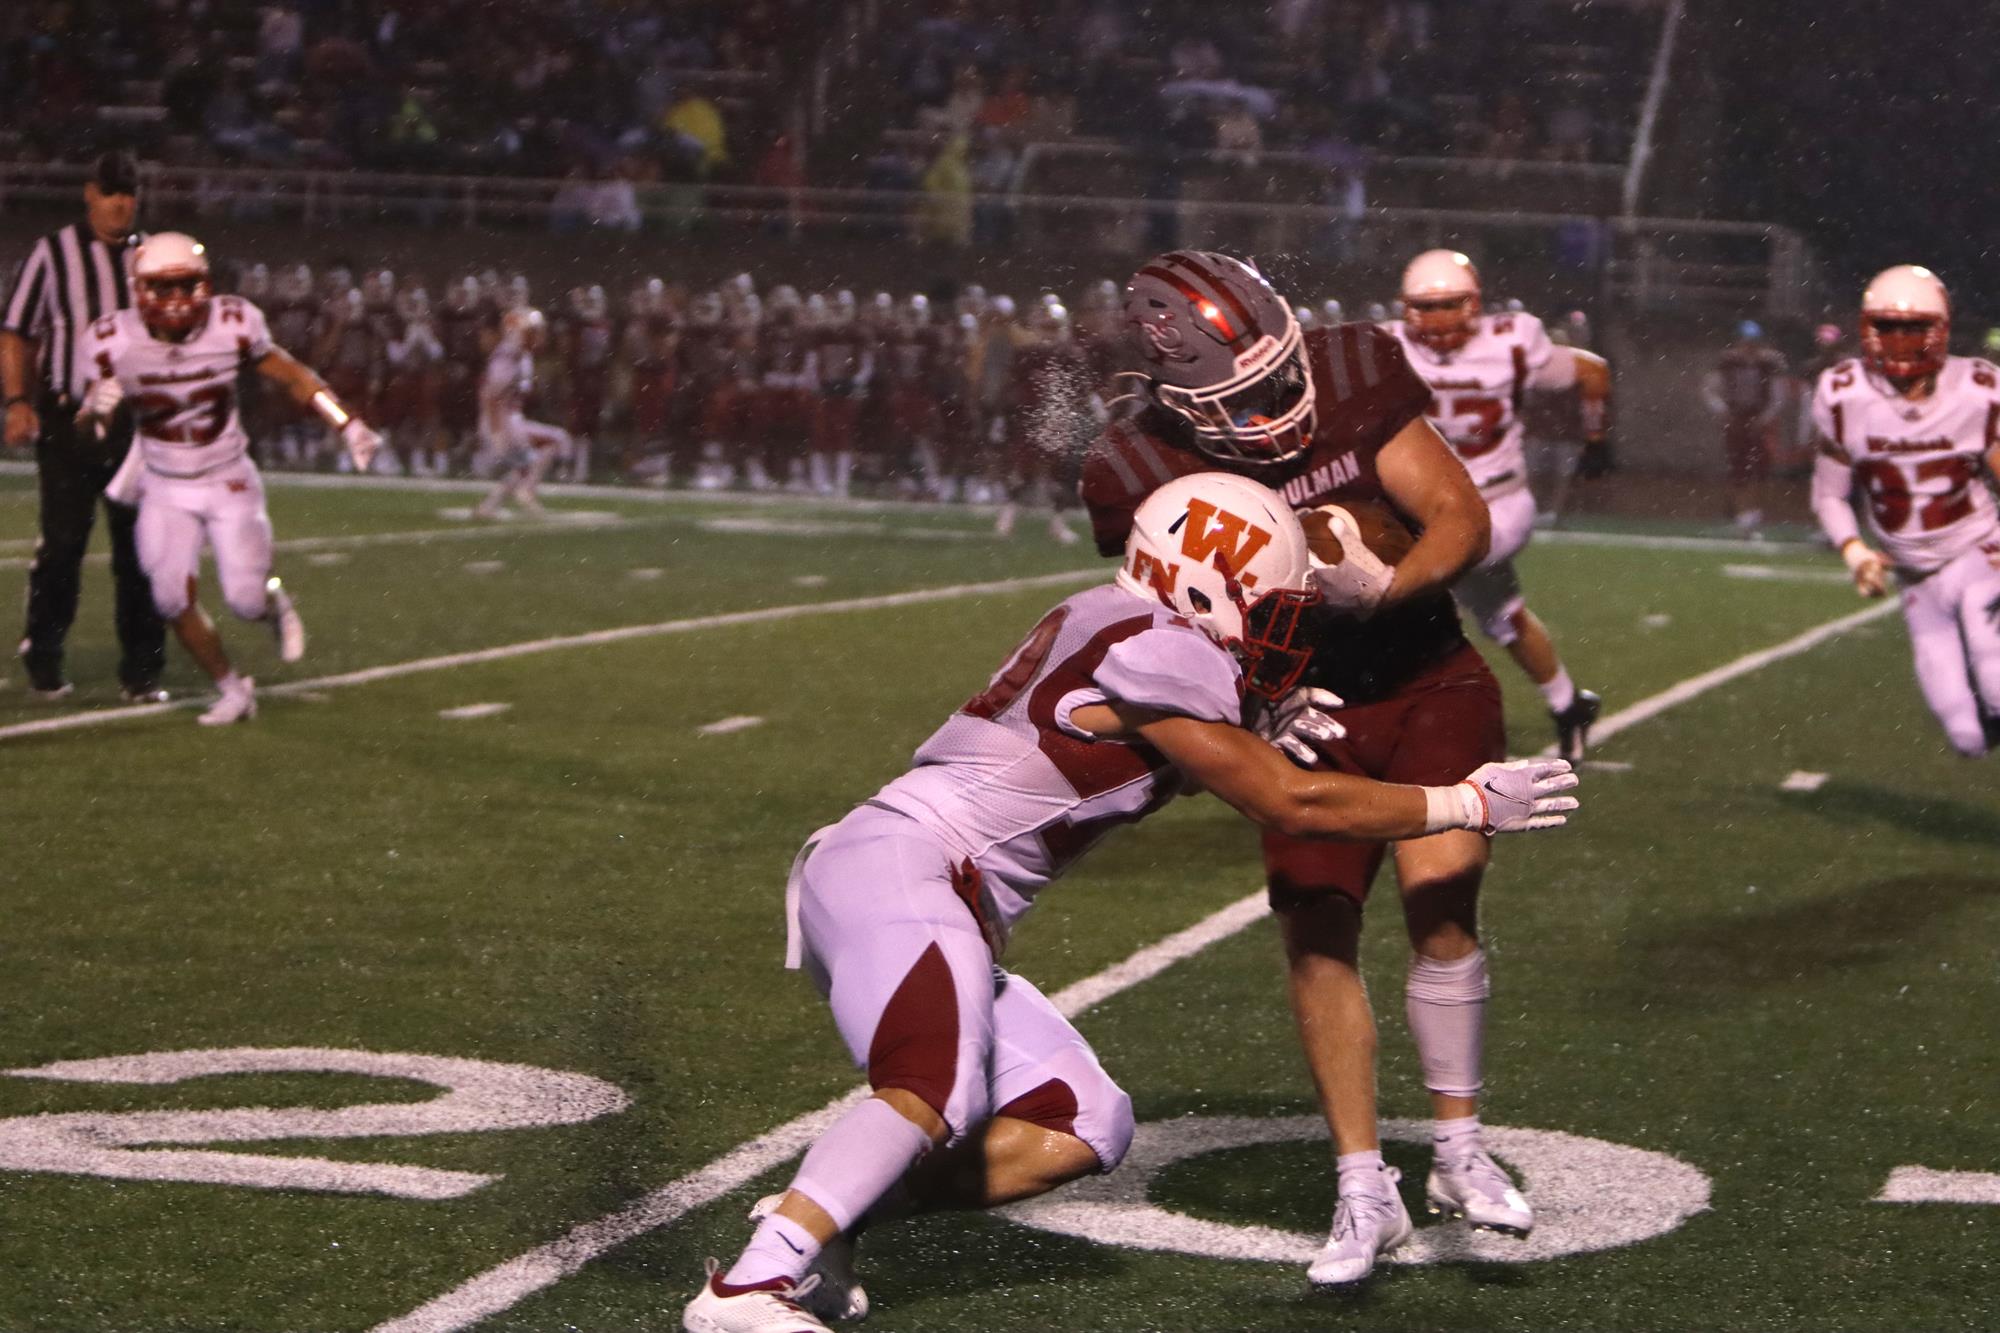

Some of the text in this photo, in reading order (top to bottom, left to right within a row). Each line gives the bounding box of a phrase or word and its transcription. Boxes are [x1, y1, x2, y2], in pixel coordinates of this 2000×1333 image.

[130, 383, 232, 447] 23
[1422, 397, 1505, 459] 3
[1280, 450, 1360, 505] ULMAN
[1853, 455, 1977, 534] 92
